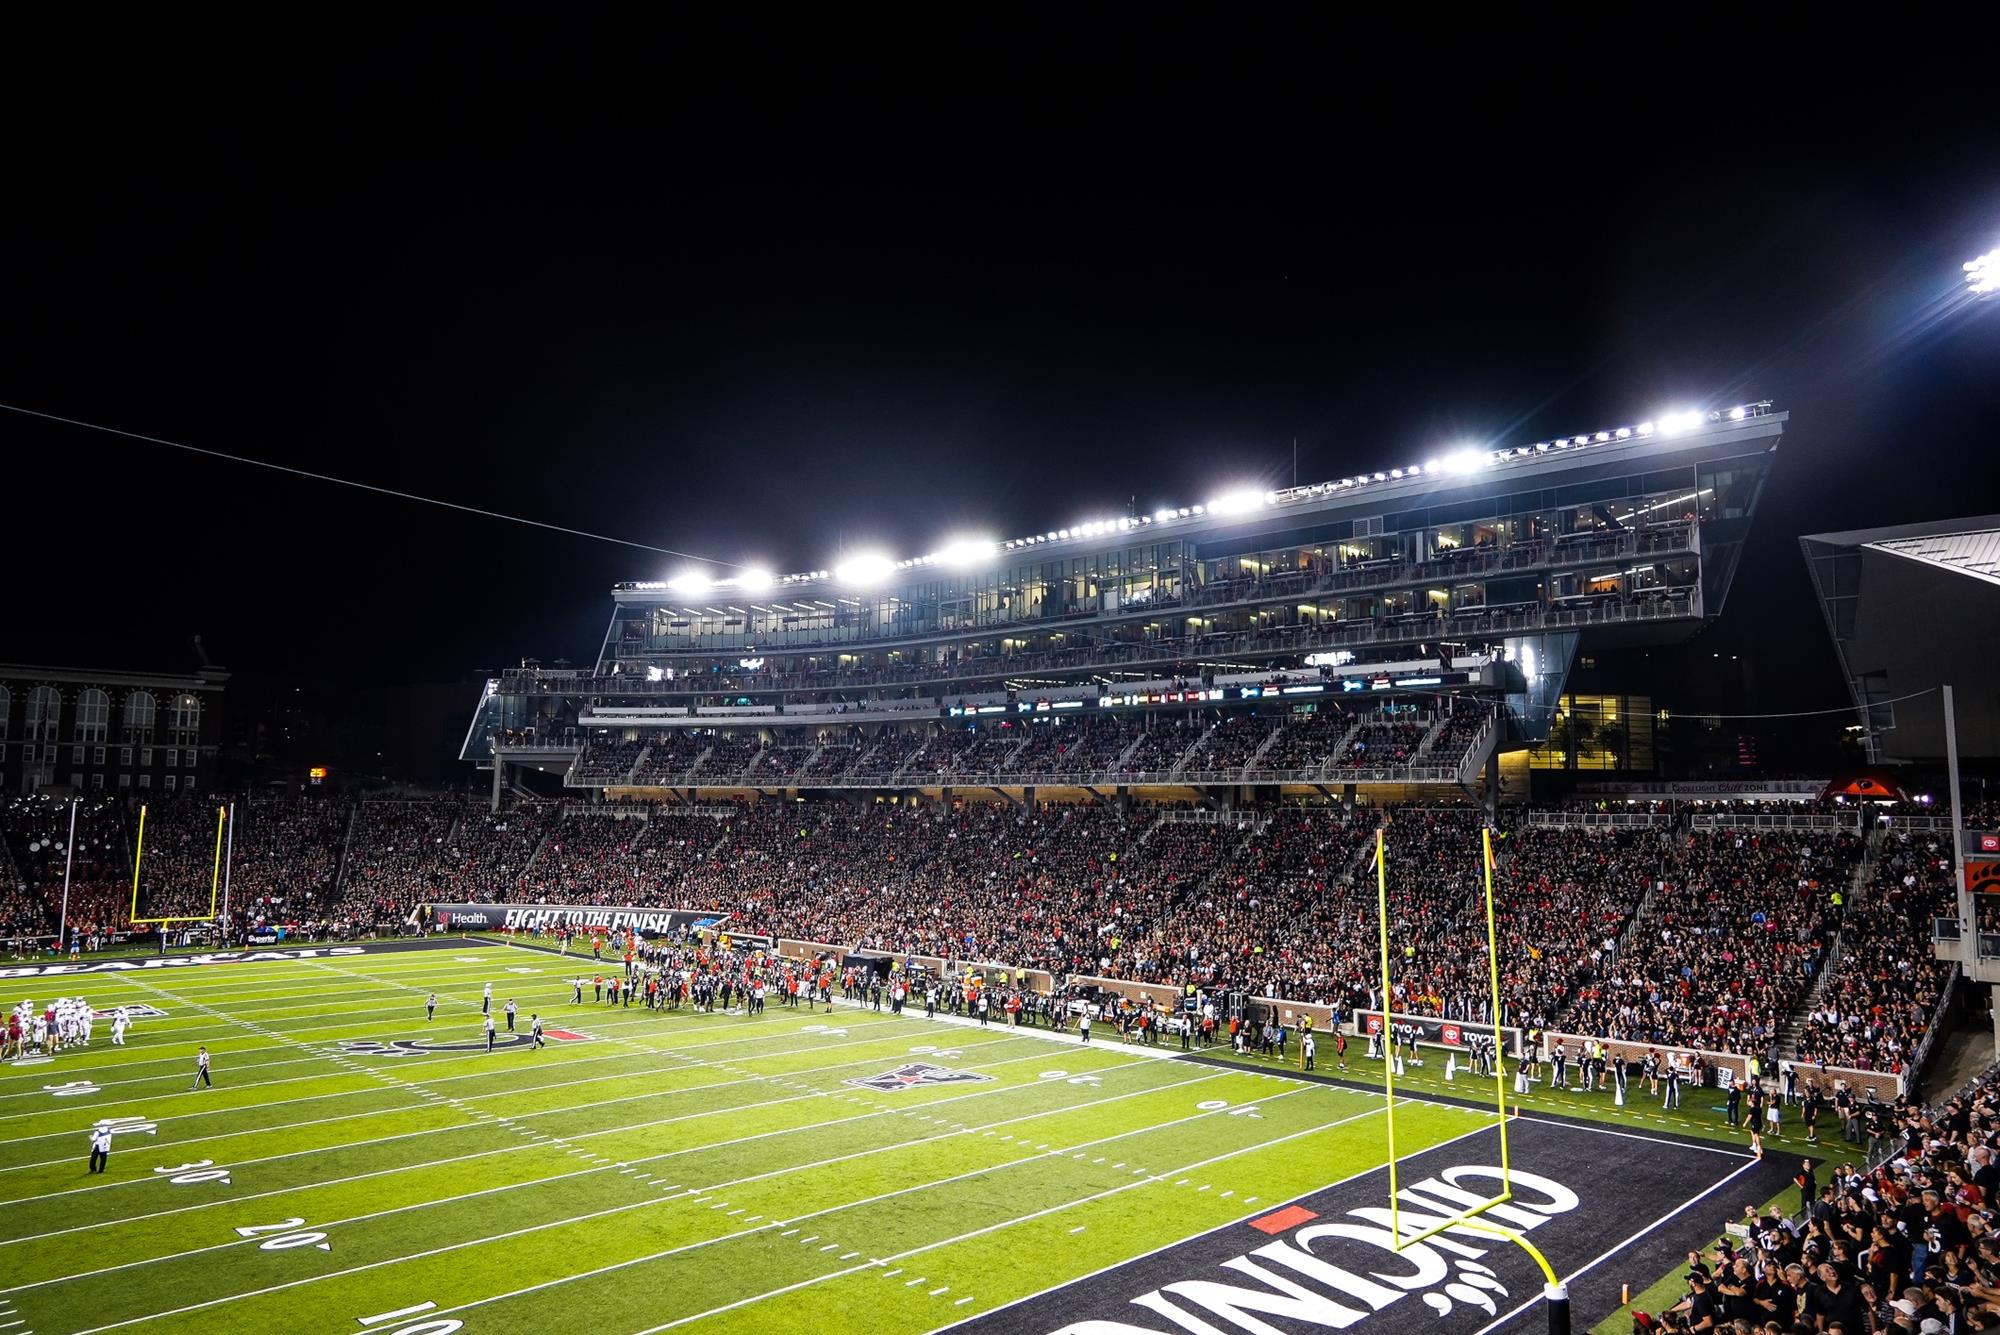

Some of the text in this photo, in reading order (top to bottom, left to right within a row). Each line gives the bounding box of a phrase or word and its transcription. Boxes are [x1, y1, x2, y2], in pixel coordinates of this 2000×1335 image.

[1744, 784, 1769, 792] ZONE
[452, 912, 488, 924] Health
[505, 909, 563, 928] FIGHT
[564, 910, 584, 926] TO
[584, 911, 613, 927] THE
[611, 912, 672, 934] FINISH
[1388, 1022, 1425, 1036] OYOA
[1462, 1031, 1499, 1045] TOYOT
[153, 1159, 231, 1184] 30
[233, 1217, 330, 1250] 20
